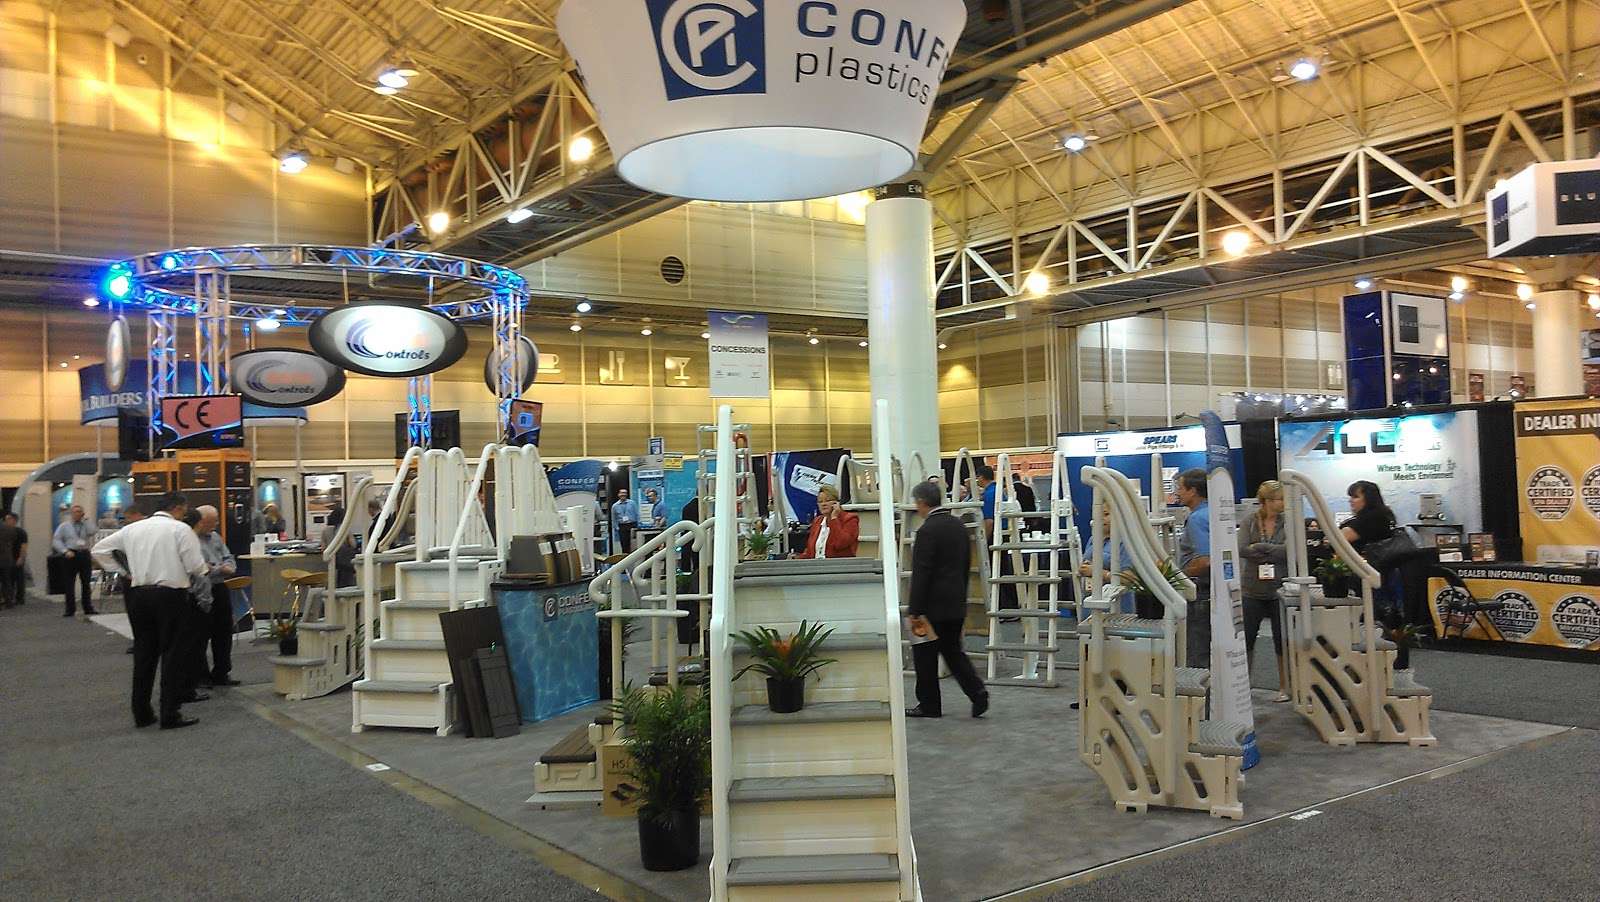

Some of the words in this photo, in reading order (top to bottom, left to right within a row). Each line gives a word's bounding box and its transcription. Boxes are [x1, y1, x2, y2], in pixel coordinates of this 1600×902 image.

[795, 47, 930, 105] plastics
[1560, 192, 1597, 202] BLU
[711, 345, 766, 354] CONCESSIONS
[1523, 414, 1577, 431] DEALER
[1404, 463, 1442, 472] Technology
[557, 477, 595, 485] CONFER
[1527, 488, 1575, 497] CERTIFIED
[1457, 569, 1486, 578] DEALER
[1488, 570, 1547, 582] INFORMATION
[1549, 573, 1582, 584] CENTER
[559, 592, 591, 608] CONFE
[1489, 609, 1539, 620] CERTIFIED
[1567, 607, 1592, 615] TRADE
[1552, 613, 1600, 626] CERTIFIE
